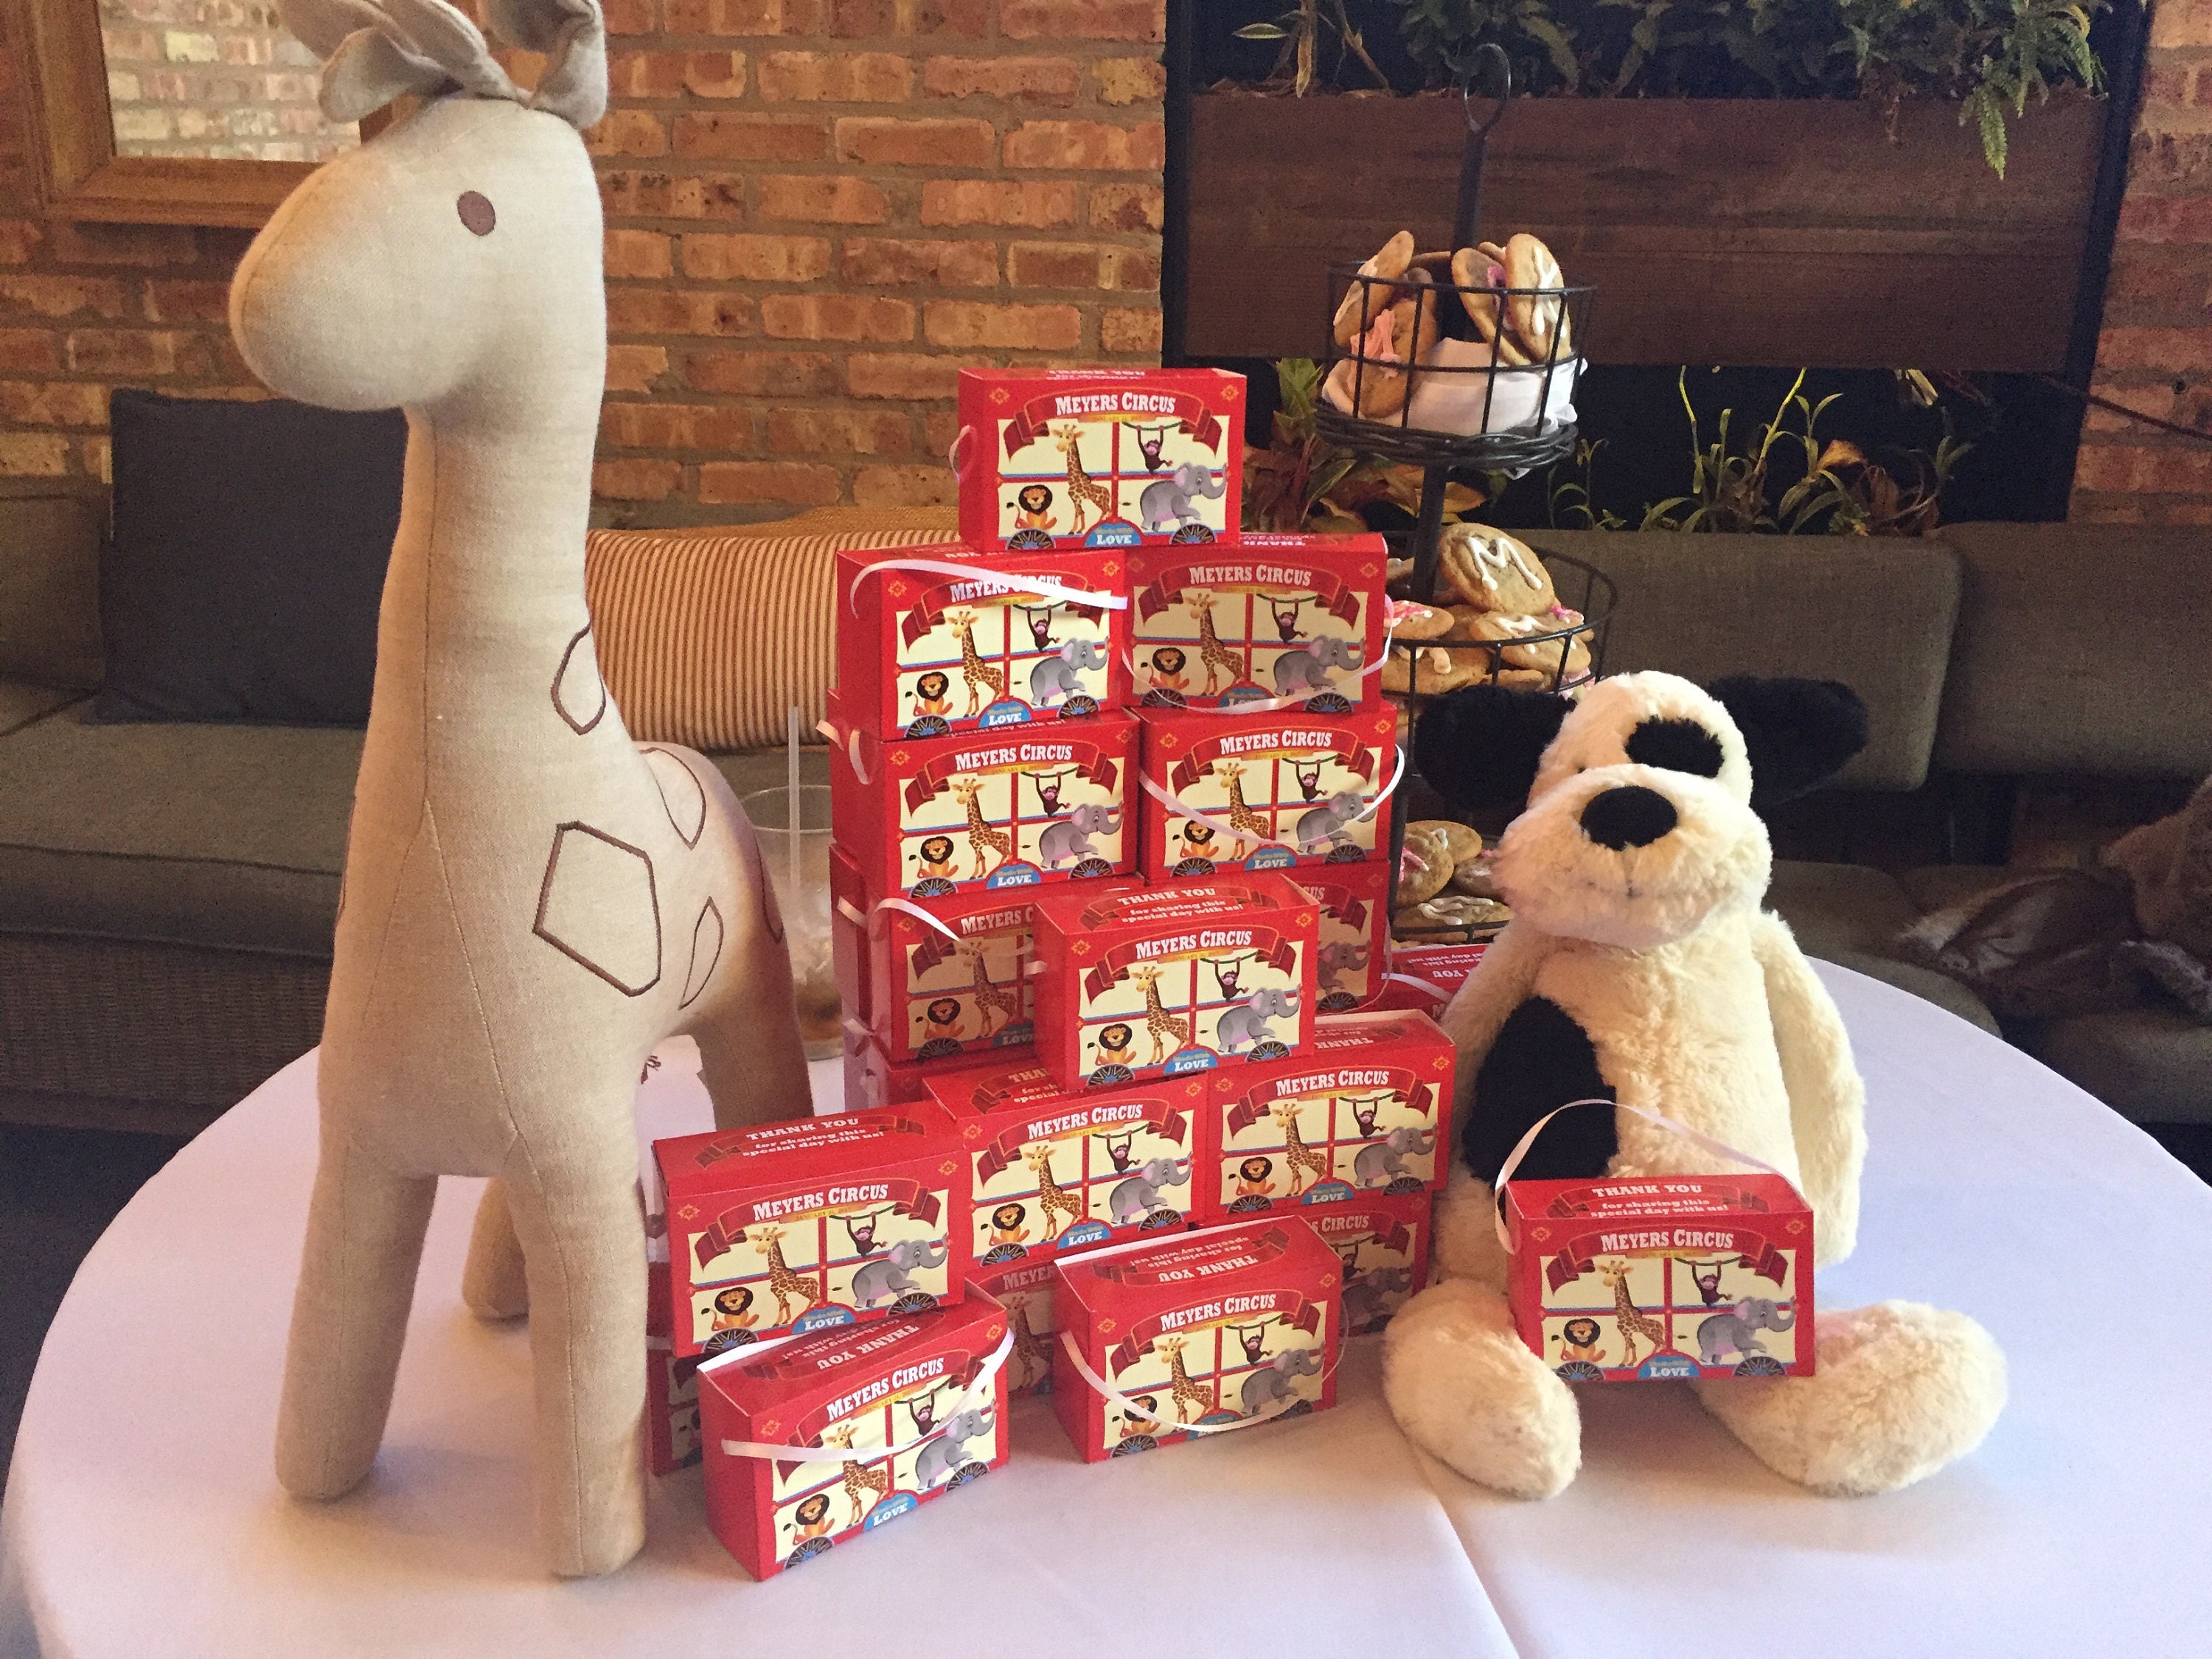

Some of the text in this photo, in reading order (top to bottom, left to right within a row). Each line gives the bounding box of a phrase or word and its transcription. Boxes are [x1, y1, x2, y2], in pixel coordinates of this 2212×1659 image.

[1055, 392, 1176, 415] MEYERS CIRCUS
[1097, 534, 1132, 546] LOVE
[1189, 564, 1312, 586] MEYERS CIRCUS
[990, 712, 1022, 726] LOVE
[1220, 733, 1279, 755] MEYERS
[1281, 730, 1332, 747] CIRCUS
[956, 747, 1016, 771] MEYERS
[1020, 745, 1072, 762] CIRCUS
[1254, 858, 1287, 869] LOVE
[998, 875, 1032, 886] LOVE
[1117, 888, 1215, 905] THANK YOU
[1121, 912, 1168, 923] special
[1194, 905, 1223, 914] with
[1151, 902, 1201, 913] sharing
[961, 911, 1021, 935] MEYERS
[1136, 936, 1196, 959] MEYERS
[1200, 931, 1253, 947] CIRCUS
[1433, 970, 1463, 978] YOU
[1175, 1059, 1208, 1072] LOVE
[1009, 1068, 1049, 1083] THA
[1276, 1070, 1389, 1096] MEYERS CIRCUS
[745, 1119, 859, 1141] THANK YOU
[1028, 1111, 1088, 1139] MEYERS
[1092, 1104, 1143, 1124] CIRCUS
[742, 1144, 796, 1157] special
[827, 1135, 860, 1144] with
[780, 1133, 836, 1144] sharing
[1312, 1192, 1345, 1203] LOVE
[1592, 1184, 1703, 1197] THANK YOU
[753, 1192, 824, 1221] MEYERS
[828, 1184, 888, 1205] CIRCUS
[1625, 1200, 1681, 1208] sharing
[1590, 1208, 1642, 1219] special
[1322, 1216, 1370, 1232] CIRCUS
[1068, 1231, 1102, 1246] LOVE
[1601, 1229, 1733, 1252] MEYERS CIRCUS
[1158, 1255, 1259, 1282] THANK YOU
[1003, 1266, 1054, 1290] MEYER
[1161, 1302, 1222, 1331] MEYERS
[1224, 1294, 1276, 1312] CIRCUS
[805, 1315, 844, 1332] LOVE
[855, 1324, 919, 1354] THANK
[816, 1351, 857, 1370] YOU
[1650, 1366, 1689, 1377] LOVE
[827, 1378, 891, 1422] MEYERS
[892, 1357, 945, 1386] CIRCUS
[873, 1503, 908, 1526] LOVE
